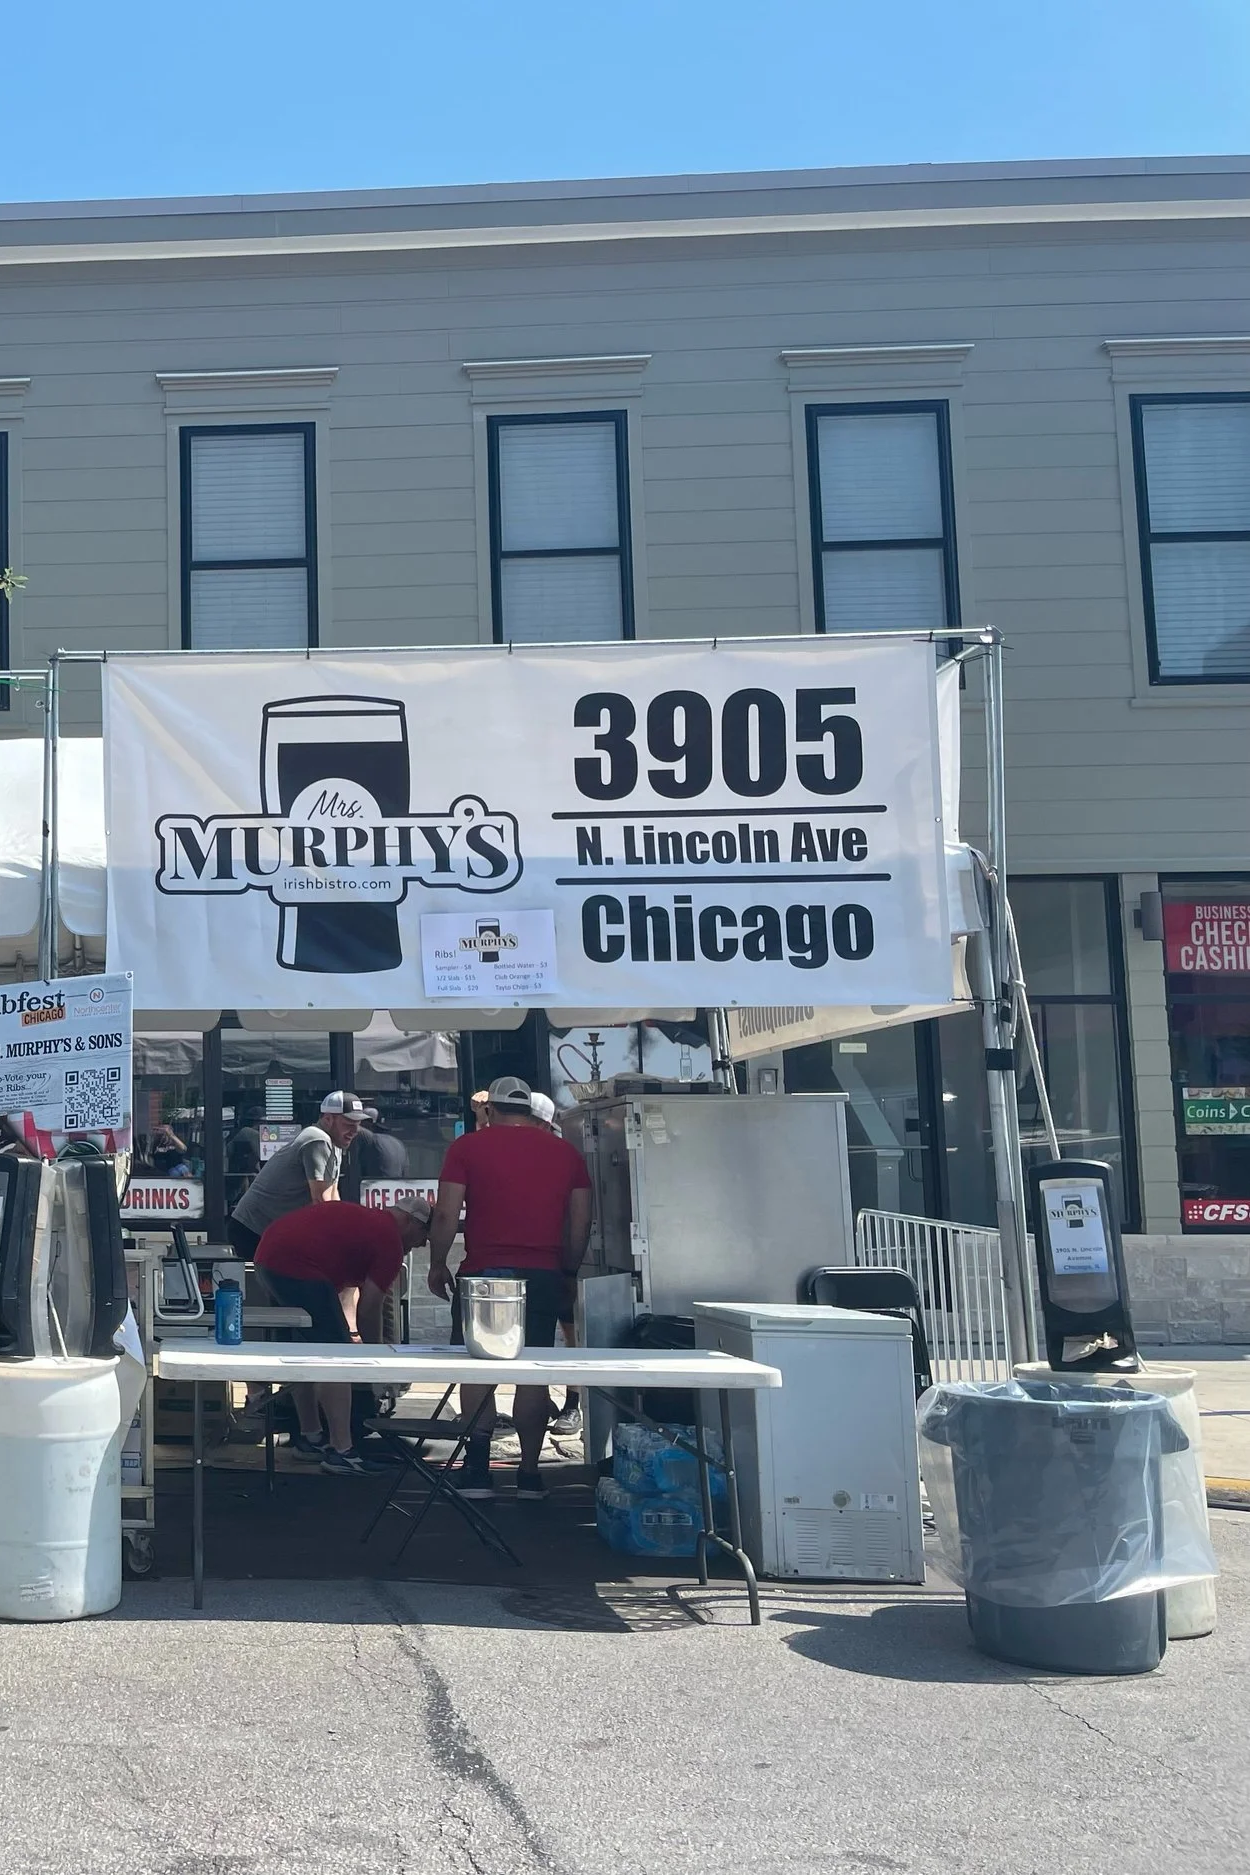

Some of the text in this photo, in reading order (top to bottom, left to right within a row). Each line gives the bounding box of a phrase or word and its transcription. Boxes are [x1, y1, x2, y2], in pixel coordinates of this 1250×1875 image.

[574, 688, 863, 801] 3905
[307, 790, 364, 820] Mrs.
[169, 807, 509, 880] MURPHY'S
[576, 822, 867, 865] N. Lincoln Ave
[283, 878, 391, 891] irishbistro.com
[582, 895, 874, 969] Chicago
[1191, 921, 1250, 945] CHEC
[434, 950, 456, 958] Ribs!
[1181, 946, 1250, 970] CASHI
[512, 983, 529, 991] Chips
[24, 1008, 64, 1025] CHICAGO
[74, 1003, 121, 1014] Northcenter
[6, 1037, 72, 1059] MURPHY'S
[75, 1036, 85, 1051] &
[88, 1033, 123, 1050] SONS
[26, 1072, 47, 1082] your
[1187, 1104, 1226, 1118] Coins
[365, 1188, 390, 1209] ICE
